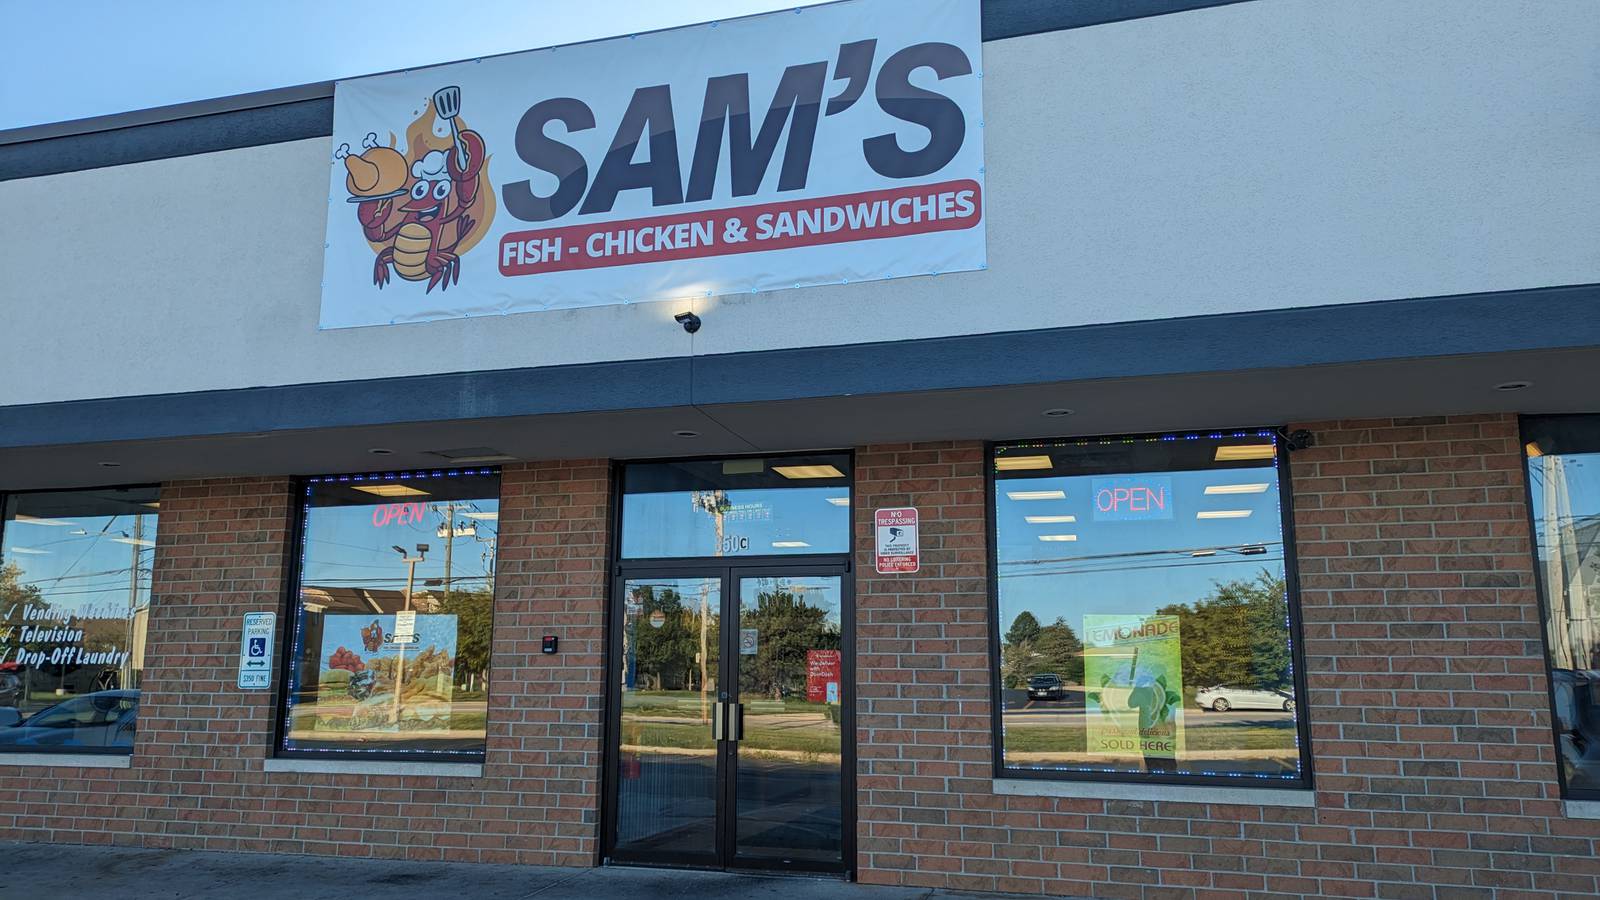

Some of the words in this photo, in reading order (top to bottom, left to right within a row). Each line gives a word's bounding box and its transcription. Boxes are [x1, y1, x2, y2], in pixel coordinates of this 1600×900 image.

[502, 38, 972, 222] SAM'S
[502, 237, 562, 267] FISH
[585, 219, 714, 258] CHICKEN
[722, 217, 749, 244] &
[755, 189, 975, 241] SANDWICHES
[1097, 486, 1164, 513] OPEN
[372, 501, 426, 528] OPEN
[22, 603, 72, 625] Vending
[246, 618, 273, 626] RESERVED
[19, 625, 83, 643] Television
[248, 627, 270, 636] PARKING
[1085, 621, 1179, 642] LEMONADE
[15, 646, 76, 670] Drop-Off
[76, 645, 130, 670] Laundry
[1100, 739, 1135, 751] SOLD
[1139, 741, 1172, 752] HERE
